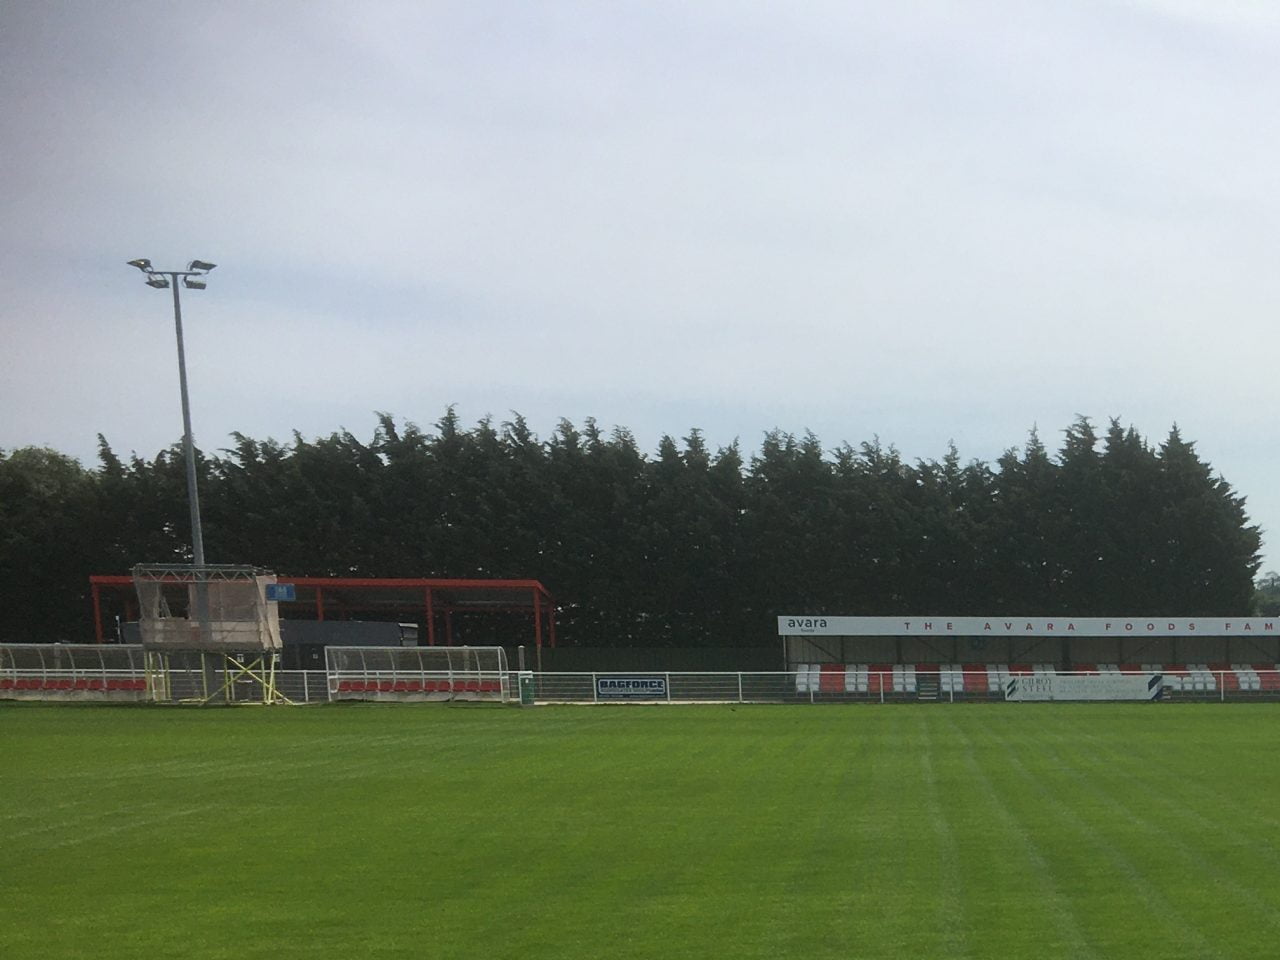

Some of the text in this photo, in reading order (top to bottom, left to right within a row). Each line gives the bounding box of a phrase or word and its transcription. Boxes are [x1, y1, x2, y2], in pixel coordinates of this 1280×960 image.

[788, 619, 827, 628] avara
[904, 622, 953, 631] THE
[984, 622, 1075, 631] AVARA
[1105, 622, 1196, 631] FOODS
[600, 680, 664, 689] BAGFORCE
